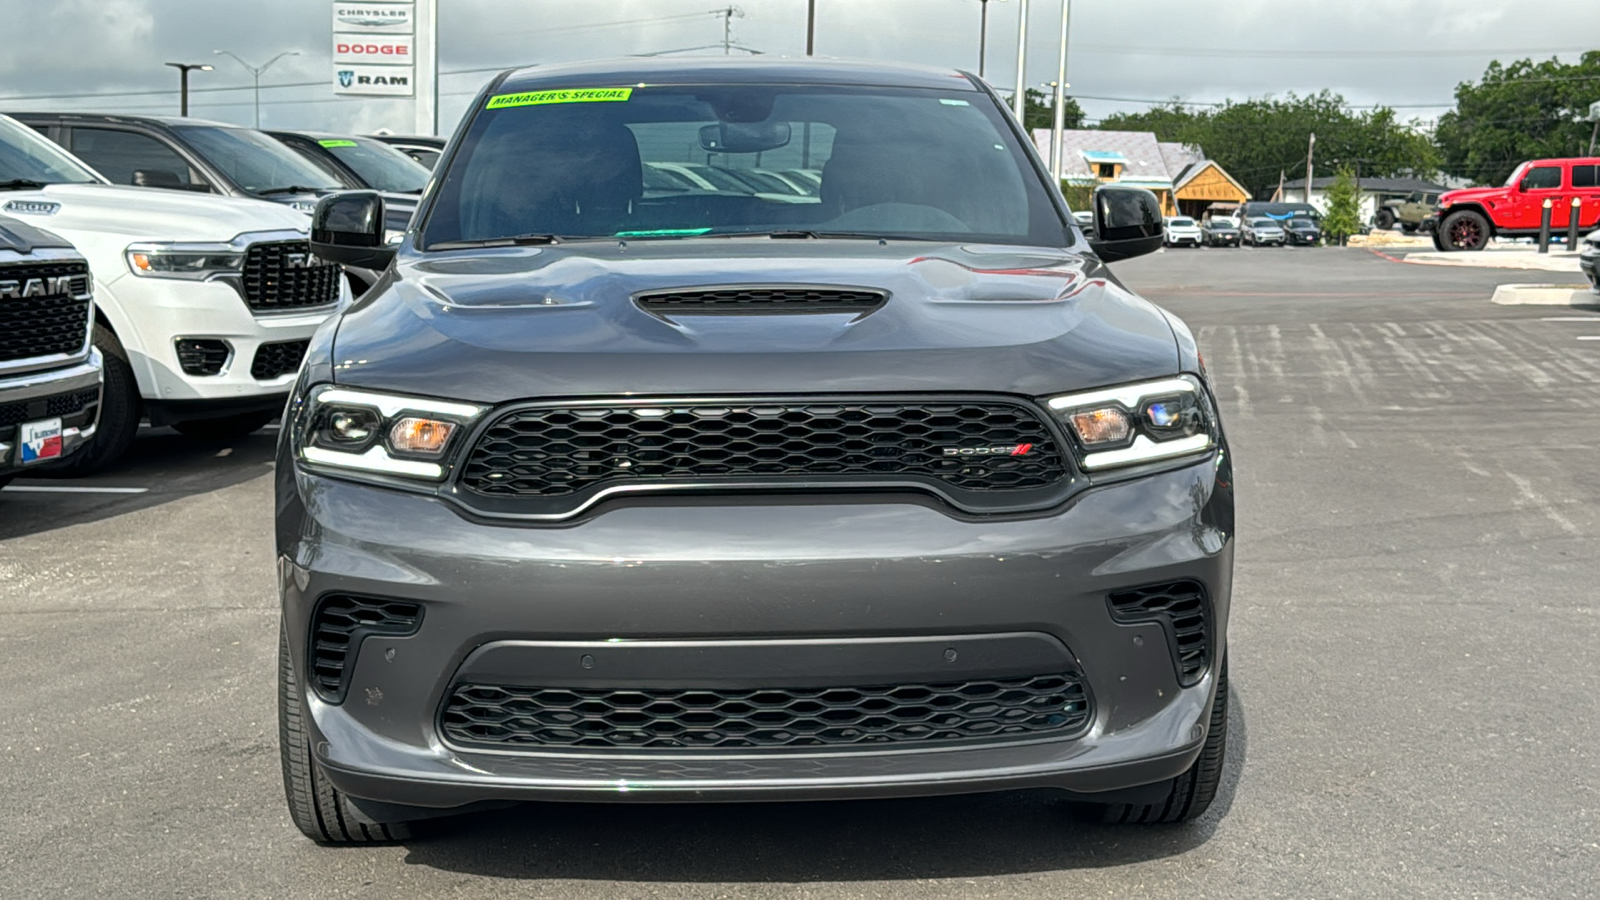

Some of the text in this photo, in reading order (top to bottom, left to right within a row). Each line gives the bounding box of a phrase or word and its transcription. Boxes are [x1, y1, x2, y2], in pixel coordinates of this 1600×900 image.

[338, 9, 406, 17] CHRYSLER
[337, 44, 408, 55] DODGE
[357, 75, 408, 86] RAM
[494, 90, 626, 105] MANAGER'S SPECIAL
[11, 202, 52, 211] 1500
[0, 275, 71, 299] RAM
[943, 447, 1019, 455] DODGE
